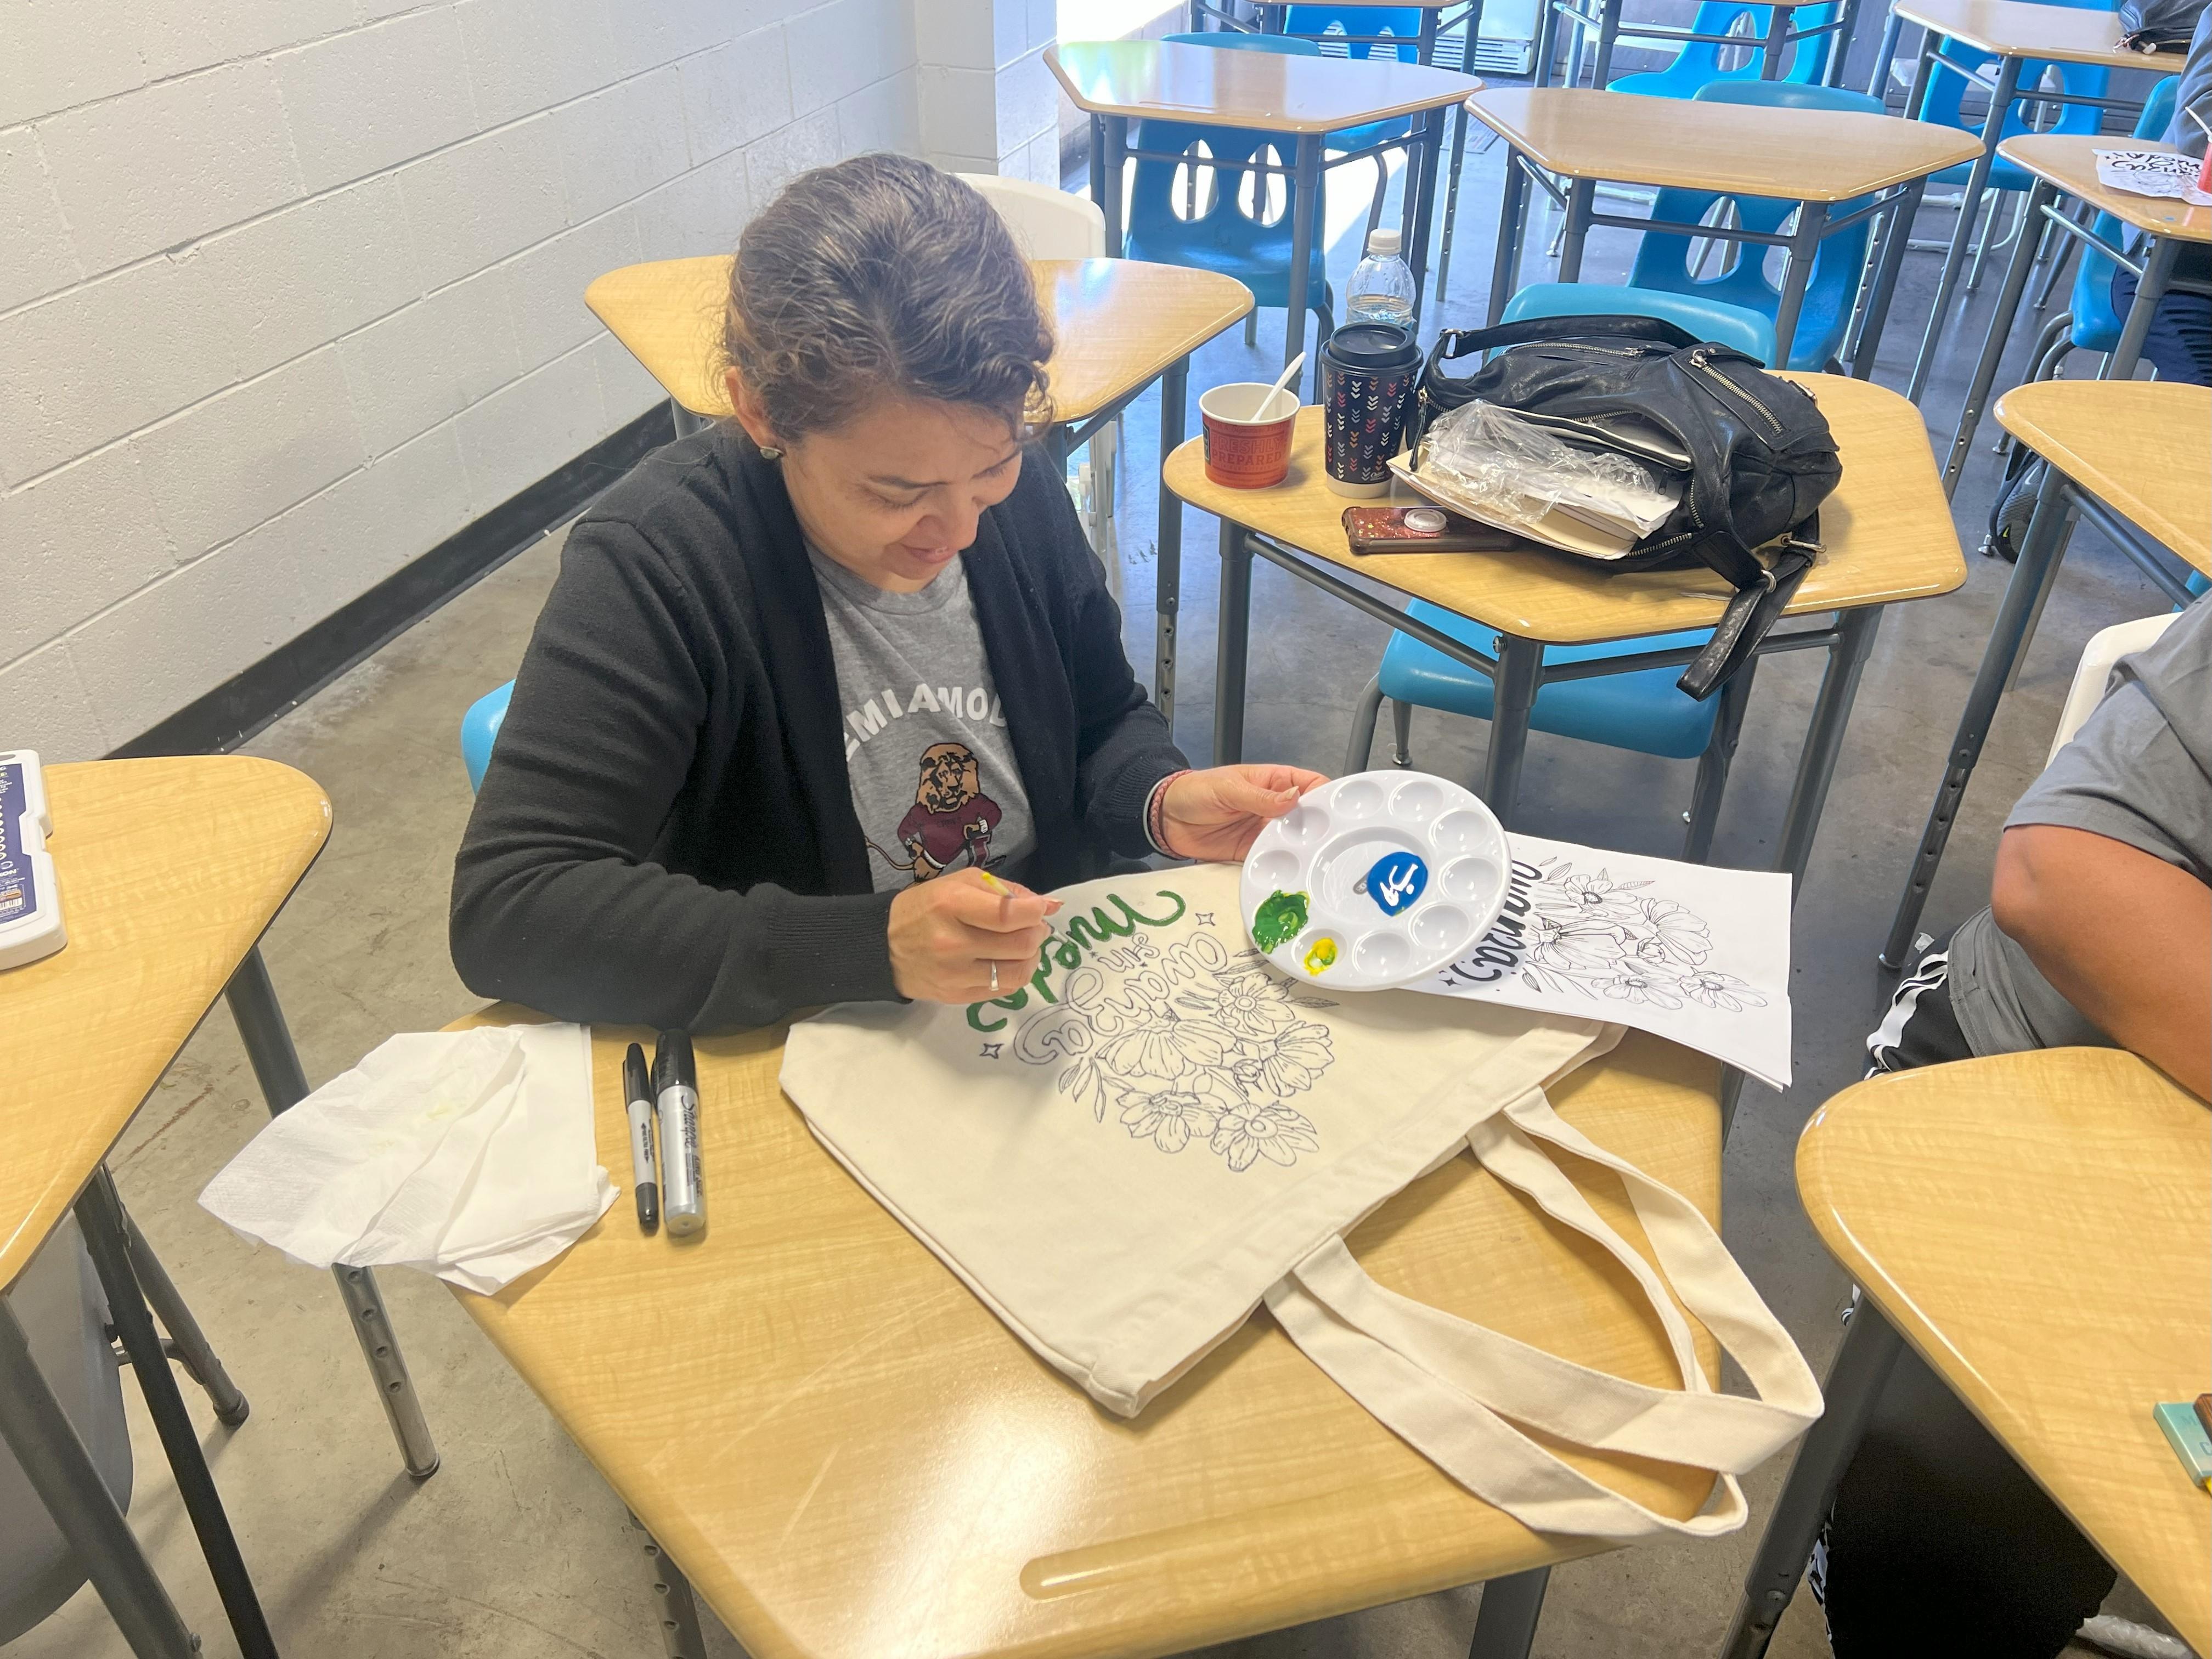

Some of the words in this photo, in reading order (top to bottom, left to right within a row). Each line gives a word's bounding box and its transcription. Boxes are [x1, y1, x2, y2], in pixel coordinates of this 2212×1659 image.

[1211, 433, 1283, 455] FRESHLY
[1211, 447, 1282, 466] PREPARED
[1097, 933, 1160, 973] sin
[1013, 932, 1228, 1065] avanza
